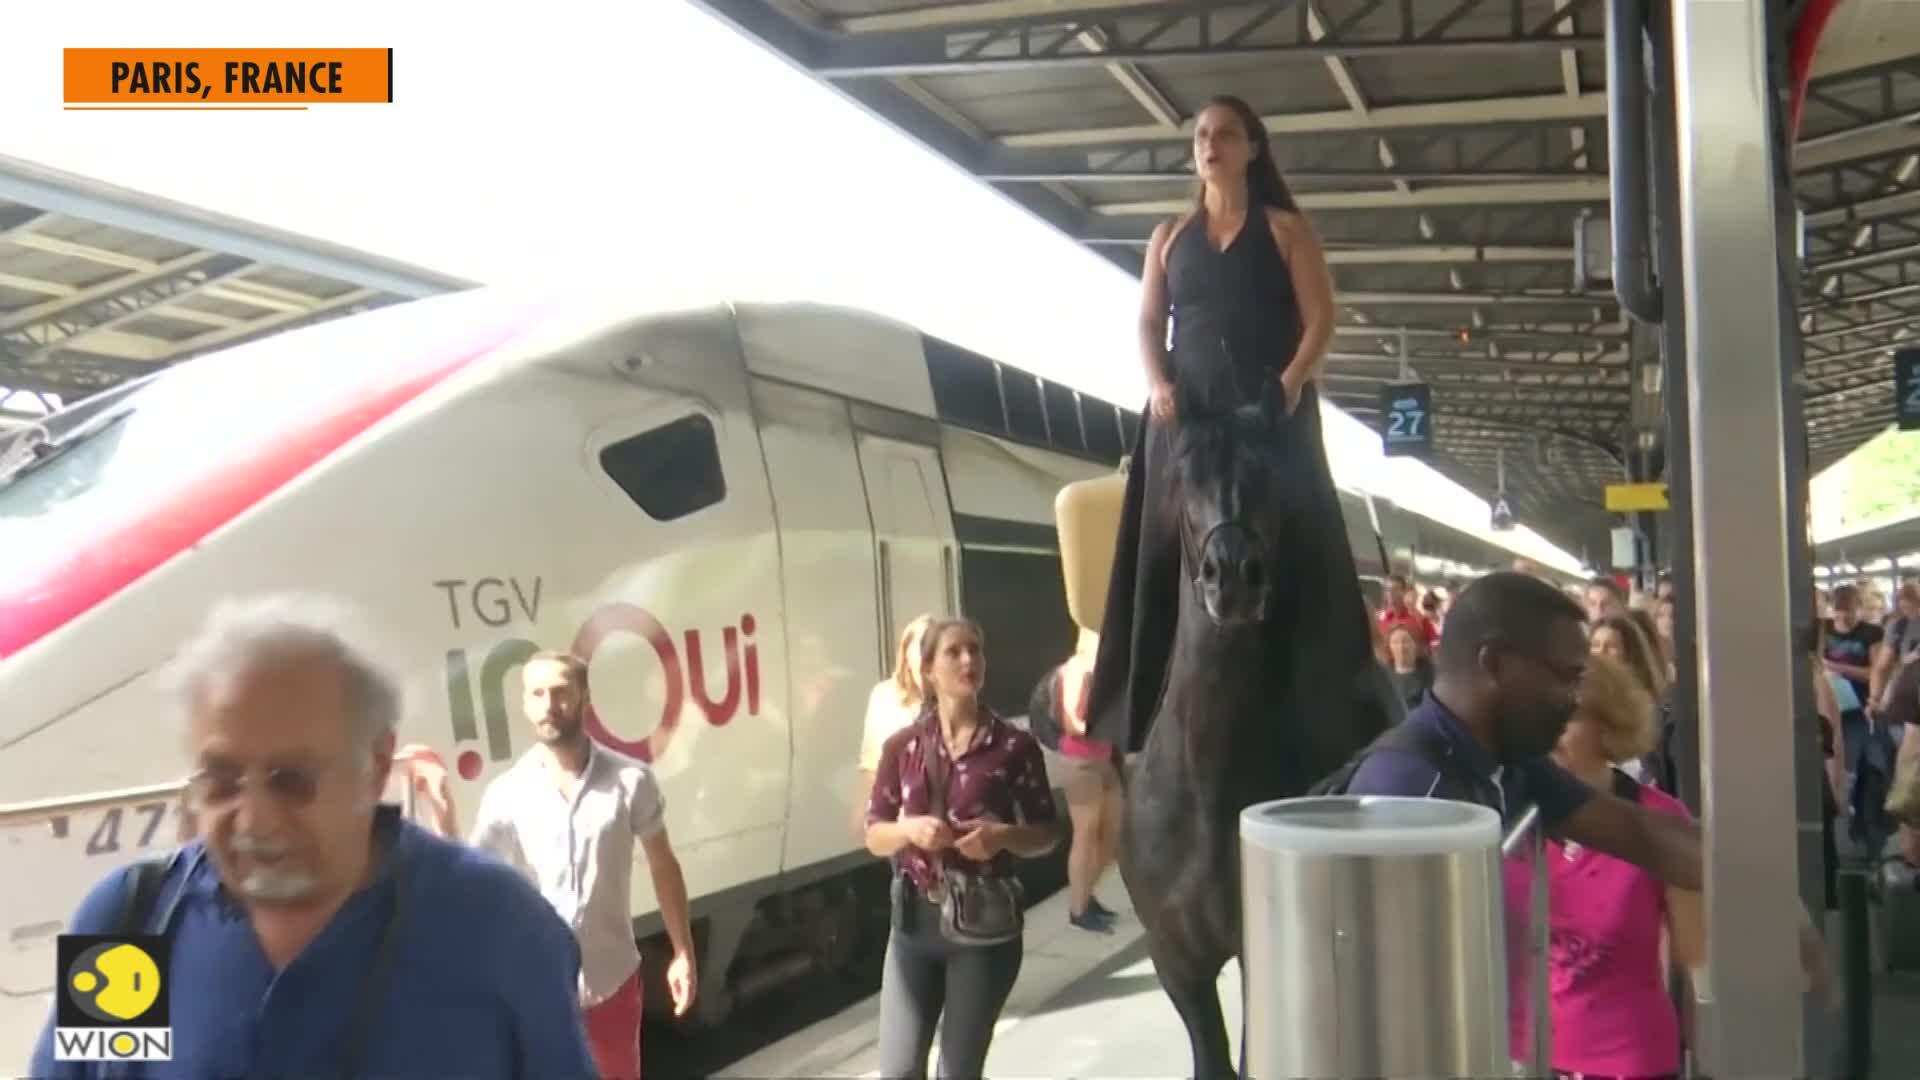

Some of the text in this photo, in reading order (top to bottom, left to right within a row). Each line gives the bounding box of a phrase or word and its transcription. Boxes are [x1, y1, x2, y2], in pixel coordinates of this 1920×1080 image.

[1388, 411, 1424, 435] 27
[1494, 499, 1512, 520] A
[433, 575, 542, 630] TGV
[85, 801, 169, 856] 47
